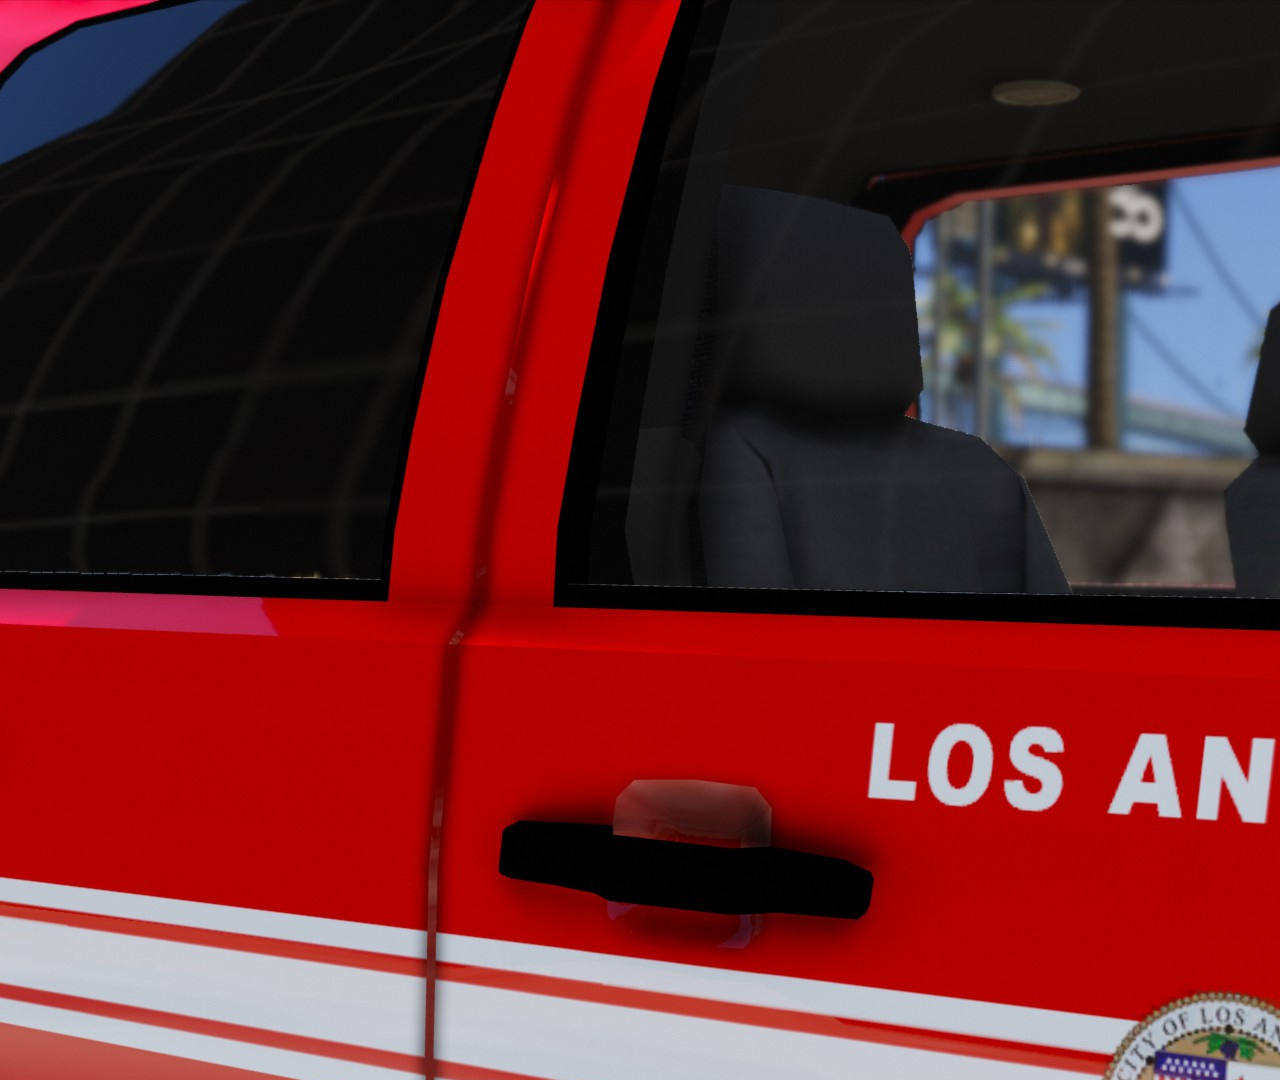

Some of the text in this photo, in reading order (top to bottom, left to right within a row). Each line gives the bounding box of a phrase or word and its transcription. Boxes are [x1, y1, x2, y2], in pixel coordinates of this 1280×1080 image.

[867, 721, 1066, 813] LOS
[1162, 1012, 1190, 1037] OF
[1199, 1005, 1246, 1026] LOS
